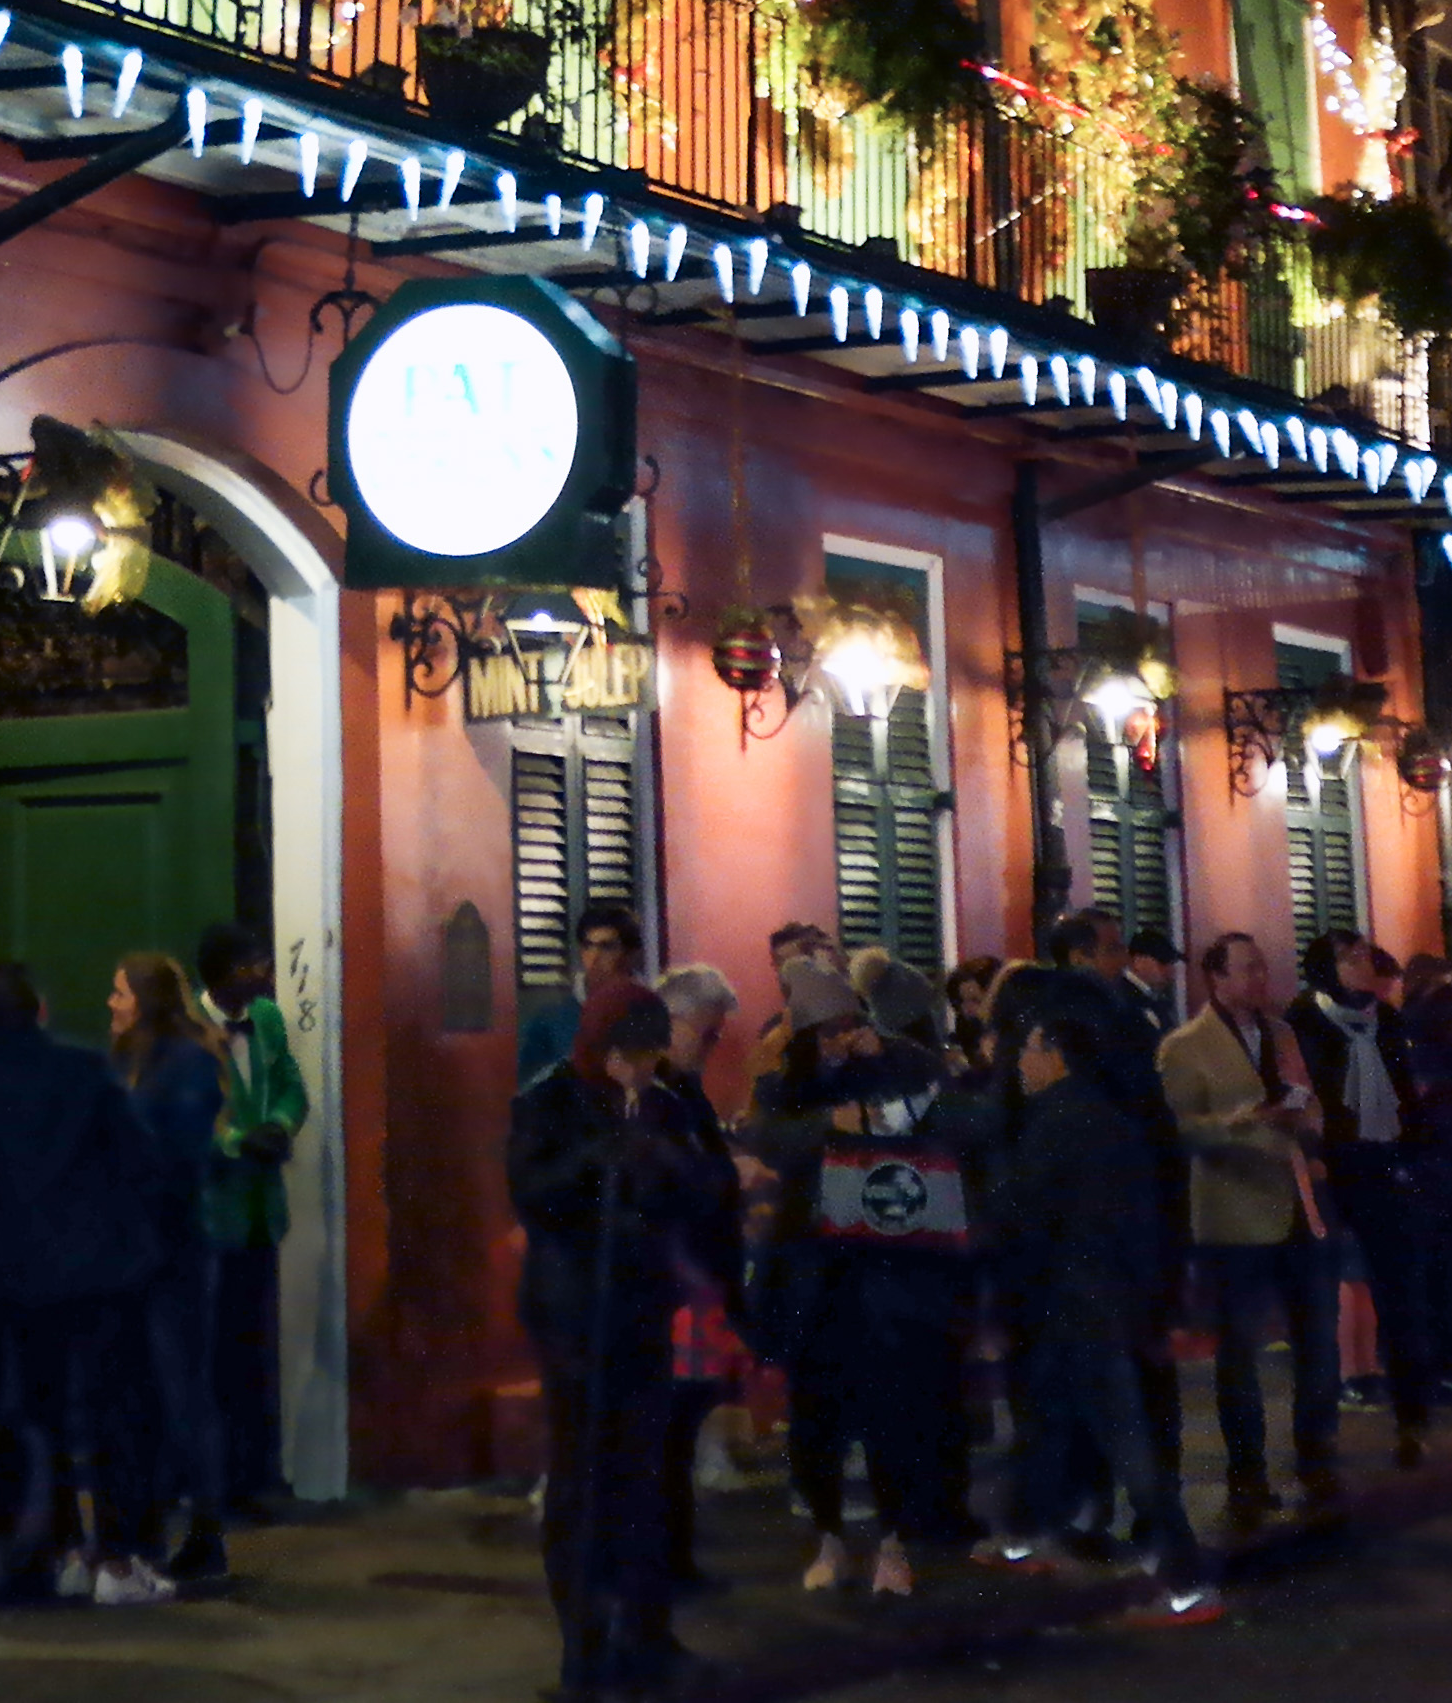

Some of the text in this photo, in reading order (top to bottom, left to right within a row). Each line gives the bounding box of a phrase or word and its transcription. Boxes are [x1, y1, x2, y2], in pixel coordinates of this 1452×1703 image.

[403, 358, 529, 419] PAT
[469, 643, 650, 718] MINT JULEP
[290, 937, 318, 1033] 718
